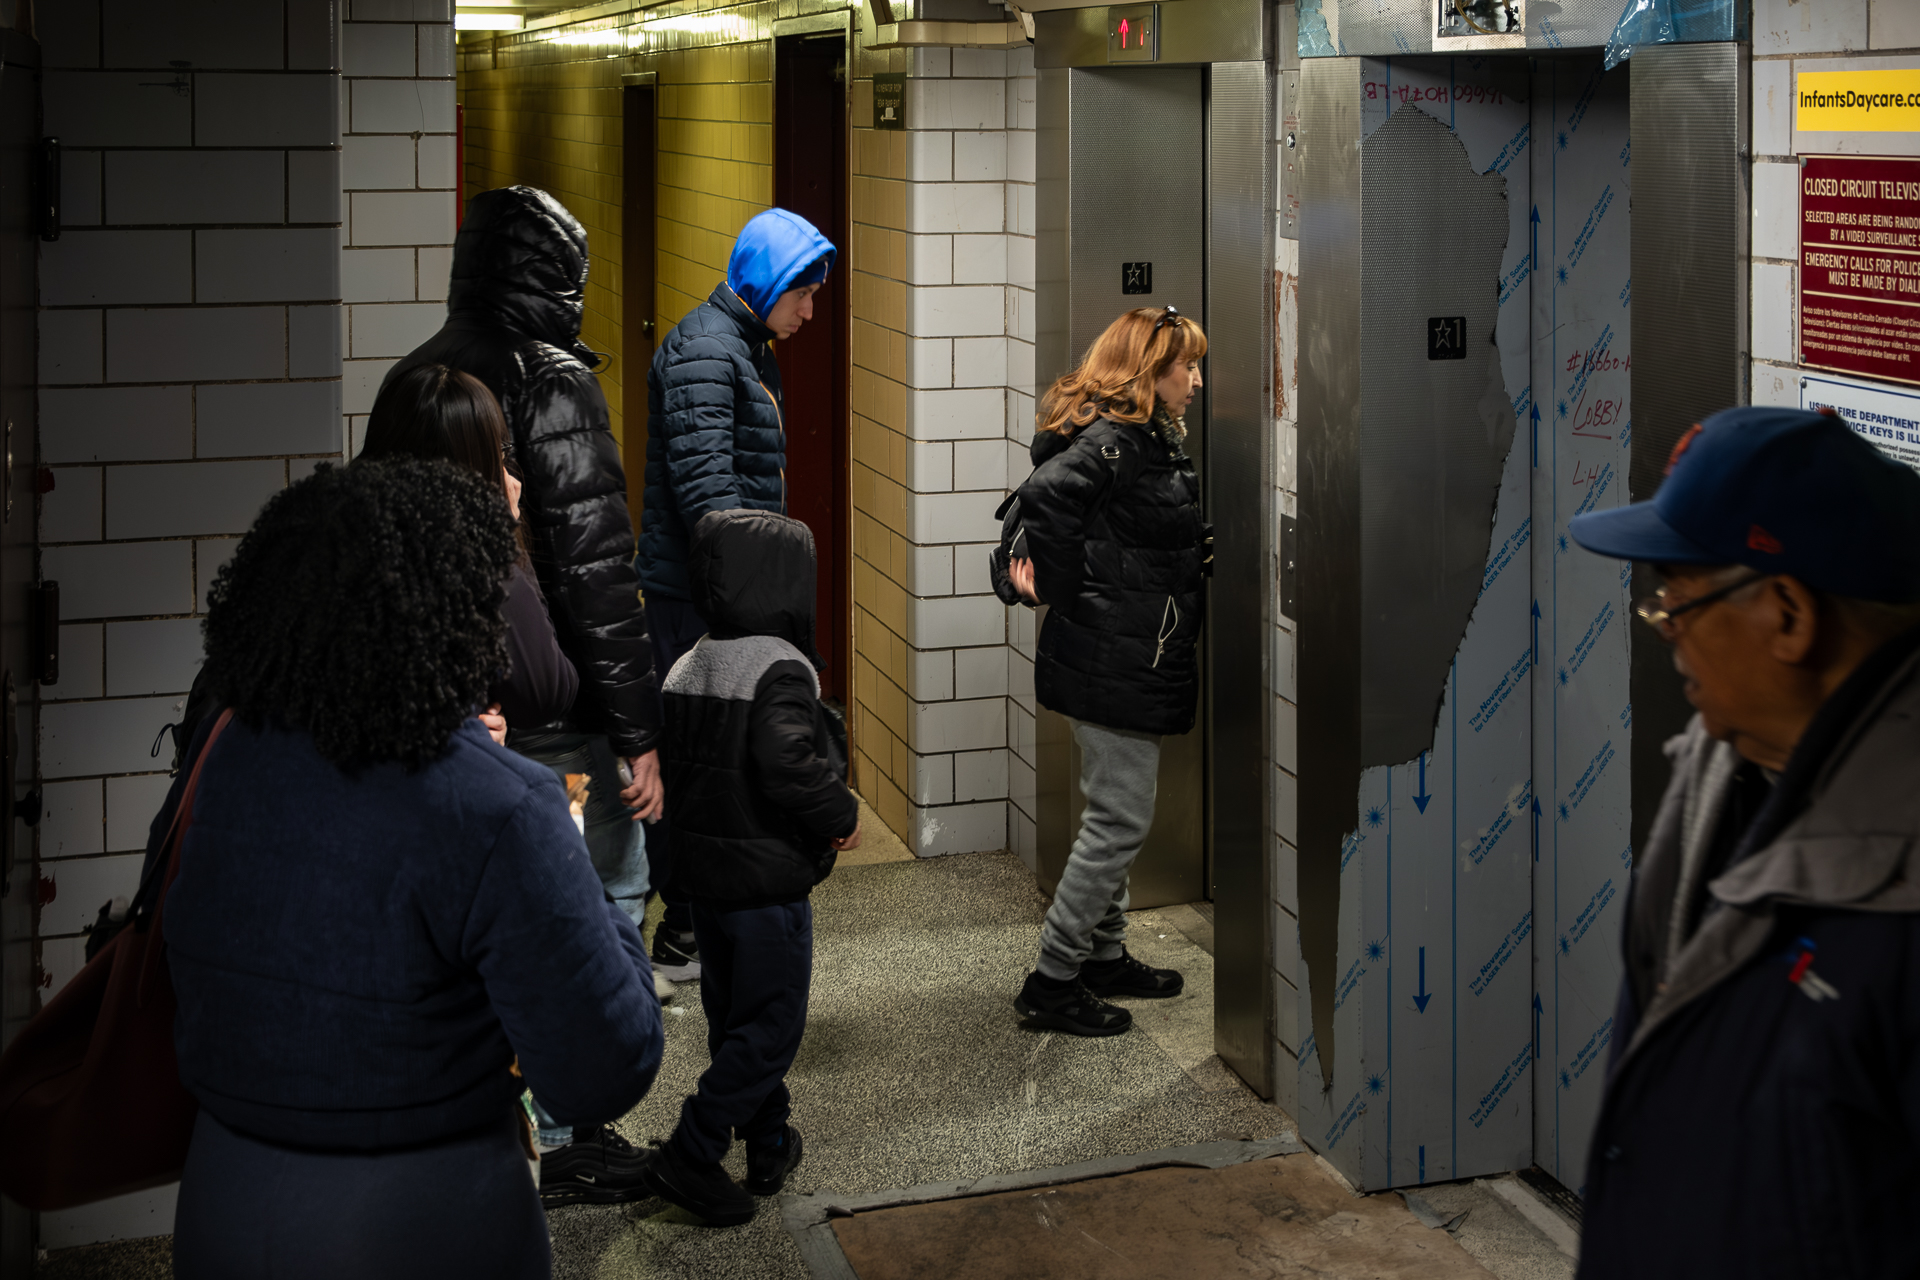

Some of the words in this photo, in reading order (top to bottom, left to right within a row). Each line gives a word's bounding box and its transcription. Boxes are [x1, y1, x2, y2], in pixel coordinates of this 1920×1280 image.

[1510, 122, 1530, 146] Solutio
[1512, 136, 1530, 156] LASER
[1804, 178, 1838, 197] CLOSED
[1840, 179, 1877, 198] CIRCUIT
[1805, 210, 1834, 224] SELECTED
[1836, 213, 1856, 225] AREAS
[1858, 214, 1871, 226] ARE
[1873, 215, 1893, 228] BEING
[1830, 229, 1839, 240] BY
[1840, 229, 1845, 241] A
[1846, 230, 1866, 243] VIDEO
[1867, 231, 1917, 247] SURVEILLANCE
[1510, 254, 1530, 278] Solutio
[1805, 252, 1848, 269] EMERGENCY
[1850, 256, 1874, 272] CALLS
[1876, 258, 1891, 273] FOR
[1141, 263, 1148, 286] 1
[1513, 267, 1530, 288] LASER
[1829, 271, 1849, 286] MUST
[1850, 273, 1860, 288] BE
[1862, 274, 1884, 290] MADE
[1886, 277, 1897, 291] BY
[1803, 306, 1813, 314] Aviso
[1814, 307, 1824, 316] sobre
[1831, 309, 1852, 319] Televisores
[1853, 312, 1858, 320] de
[1859, 313, 1875, 322] Circuito
[1876, 314, 1892, 324] Cerrado
[1893, 316, 1909, 326] (Closed
[1826, 320, 1840, 329] Ciertas
[1852, 323, 1880, 335] seleccionadas
[1453, 319, 1460, 348] 1
[1803, 329, 1828, 339] monitoreadas
[1842, 333, 1856, 343] sistema
[1857, 335, 1862, 344] de
[1864, 336, 1882, 347] vigilancia
[1905, 342, 1911, 350] En
[1803, 340, 1824, 350] emergencia
[1837, 344, 1857, 355] asistencia
[1857, 348, 1872, 357] policial
[1872, 348, 1883, 358] debe
[1883, 350, 1897, 360] llamar
[1898, 353, 1902, 361] al
[1511, 385, 1530, 410] Solutio
[1837, 406, 1857, 419] FIRE
[1860, 410, 1920, 431] DEPARTMENT
[1869, 425, 1893, 439] KEYS
[1896, 431, 1905, 441] IS
[1510, 516, 1531, 541] Solutio
[1482, 570, 1499, 591] LASER
[1498, 554, 1512, 571] Fiber
[1513, 530, 1531, 551] LASER
[1468, 712, 1481, 726] The
[1511, 648, 1531, 673] Solutio
[1474, 722, 1484, 733] for
[1482, 702, 1500, 723] LASER
[1498, 686, 1512, 703] Fiber
[1514, 662, 1531, 683] LASER
[1468, 844, 1481, 858] The
[1474, 854, 1484, 865] for
[1482, 834, 1500, 855] LASER
[1498, 818, 1512, 835] Fiber
[1468, 976, 1482, 990] The
[1512, 910, 1532, 936] Solutio
[1474, 986, 1484, 997] for
[1482, 965, 1500, 987] LASER
[1498, 949, 1512, 967] Fiber
[1514, 924, 1532, 946] LASER
[1468, 1108, 1482, 1122] The
[1512, 1041, 1532, 1067] Solutio
[1474, 1118, 1484, 1129] for
[1482, 1097, 1500, 1119] LASER
[1498, 1080, 1513, 1098] Fiber
[1514, 1055, 1532, 1077] LASER
